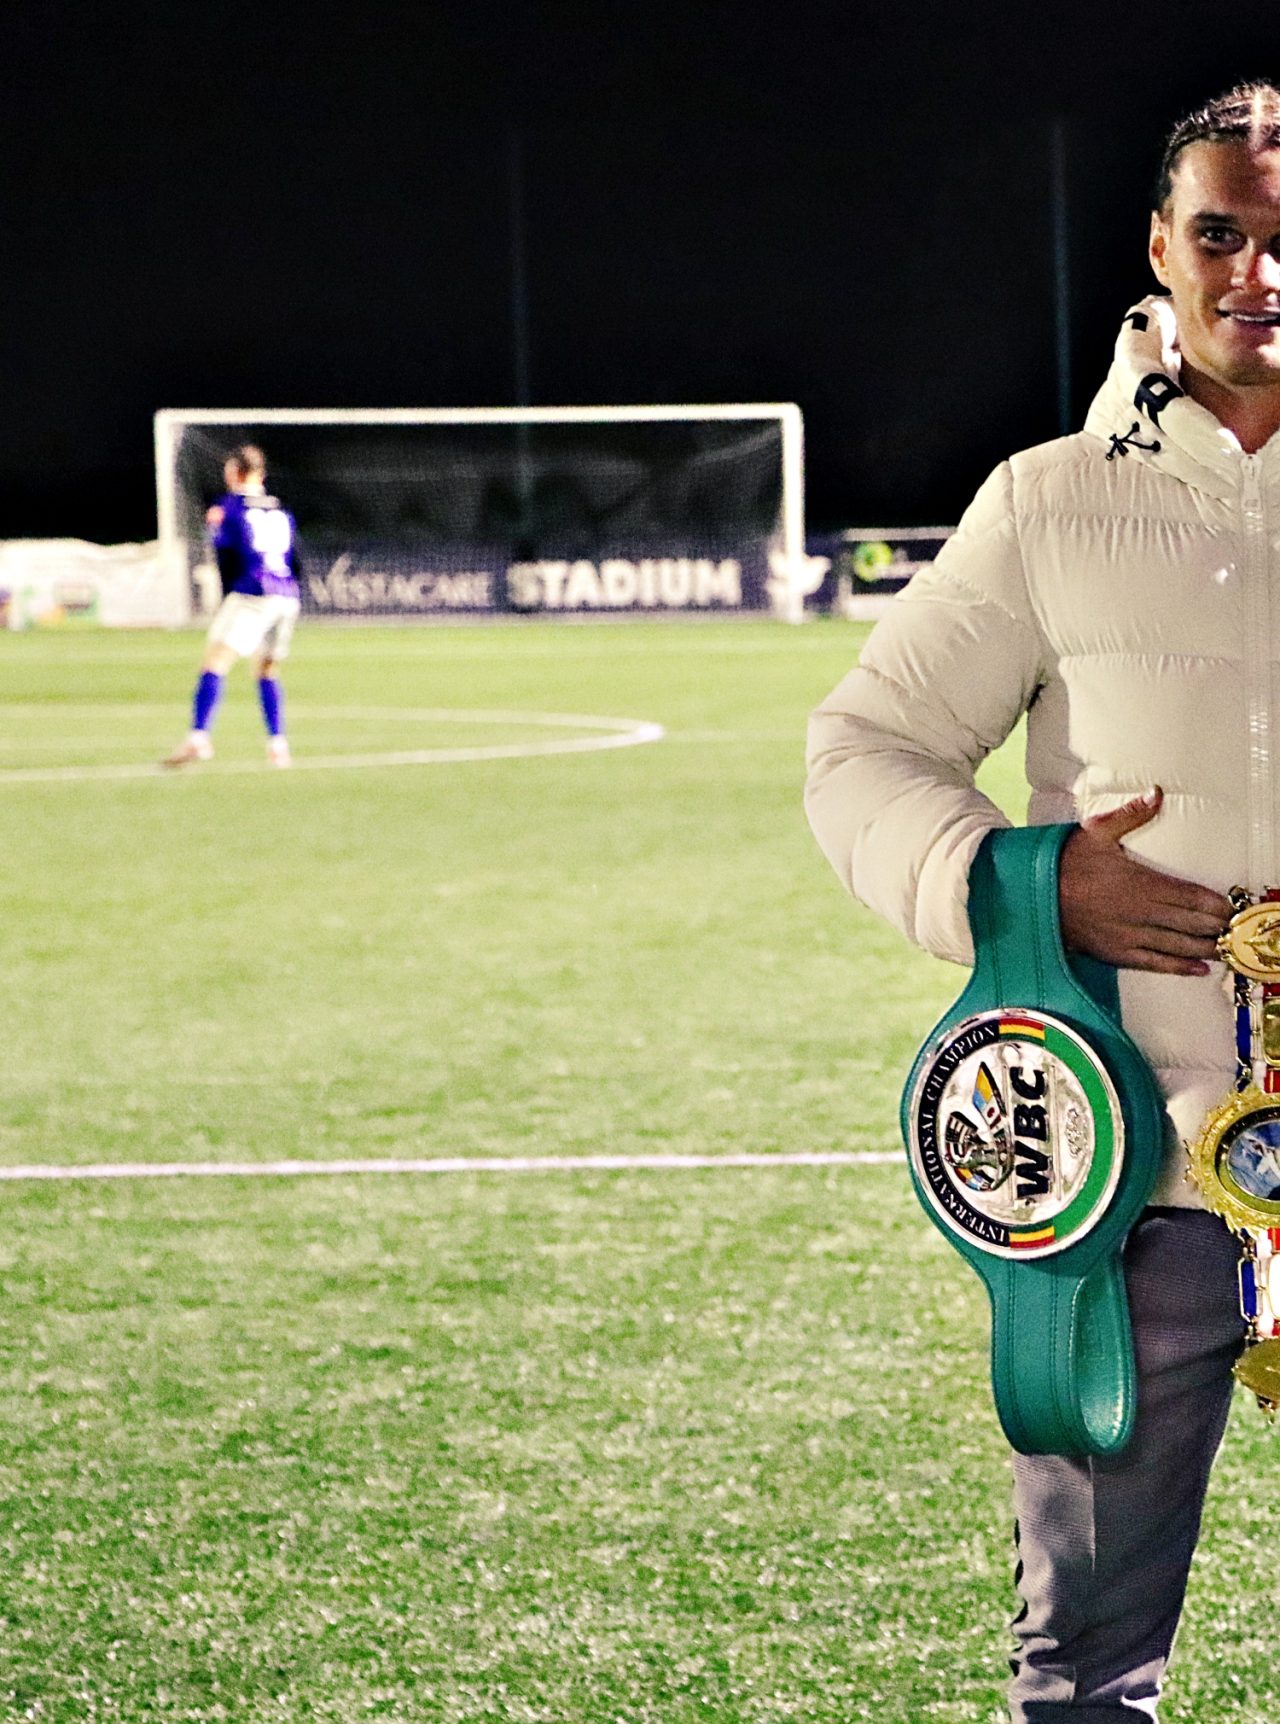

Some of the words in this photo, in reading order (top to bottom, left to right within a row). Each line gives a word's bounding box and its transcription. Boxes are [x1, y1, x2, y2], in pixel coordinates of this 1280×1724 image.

[506, 558, 742, 608] STADIUM
[926, 1024, 996, 1101] CHAMPION
[921, 1110, 1006, 1243] INTERNATIONAL
[1009, 1066, 1050, 1200] WBC
